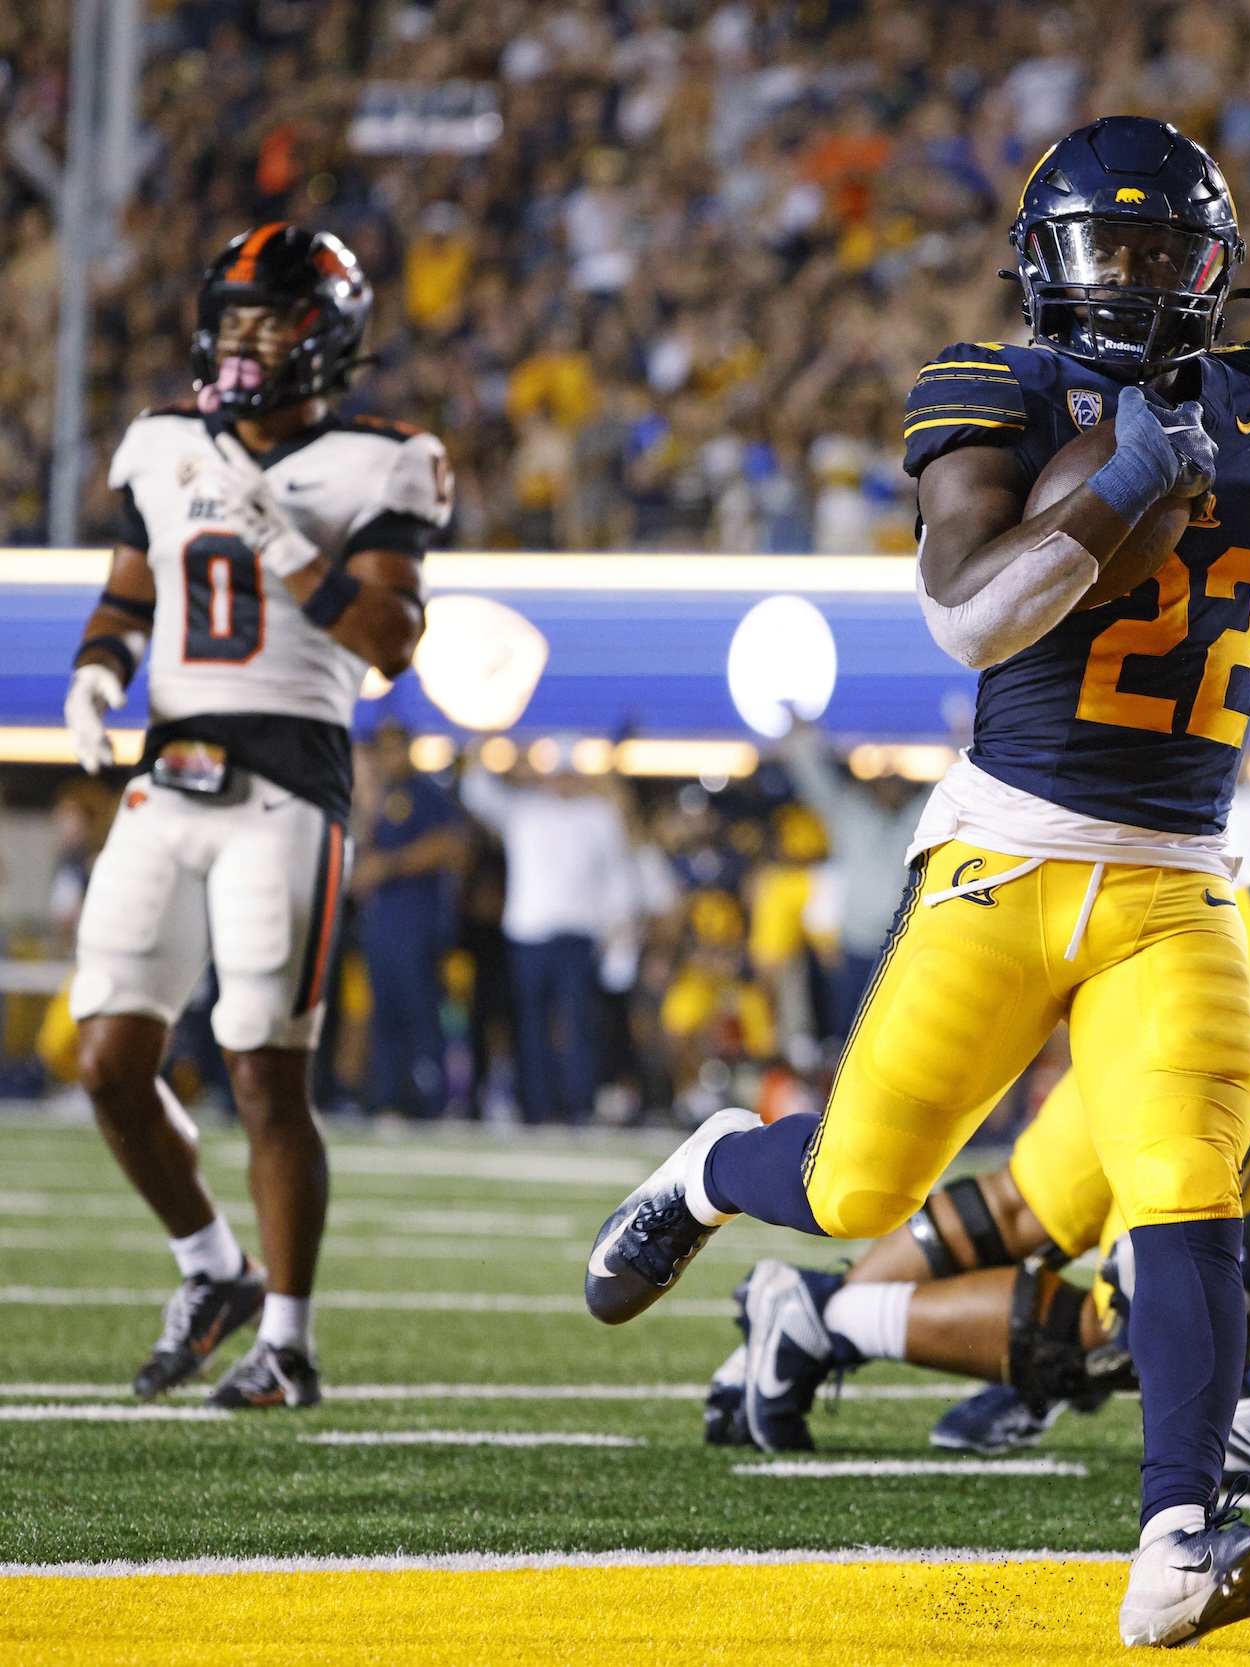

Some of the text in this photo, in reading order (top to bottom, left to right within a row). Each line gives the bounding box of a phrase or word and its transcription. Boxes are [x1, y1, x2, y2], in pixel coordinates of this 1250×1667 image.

[1104, 339, 1144, 354] Riddell
[1069, 391, 1101, 419] PAC
[1077, 408, 1095, 426] 12
[182, 529, 265, 665] 0
